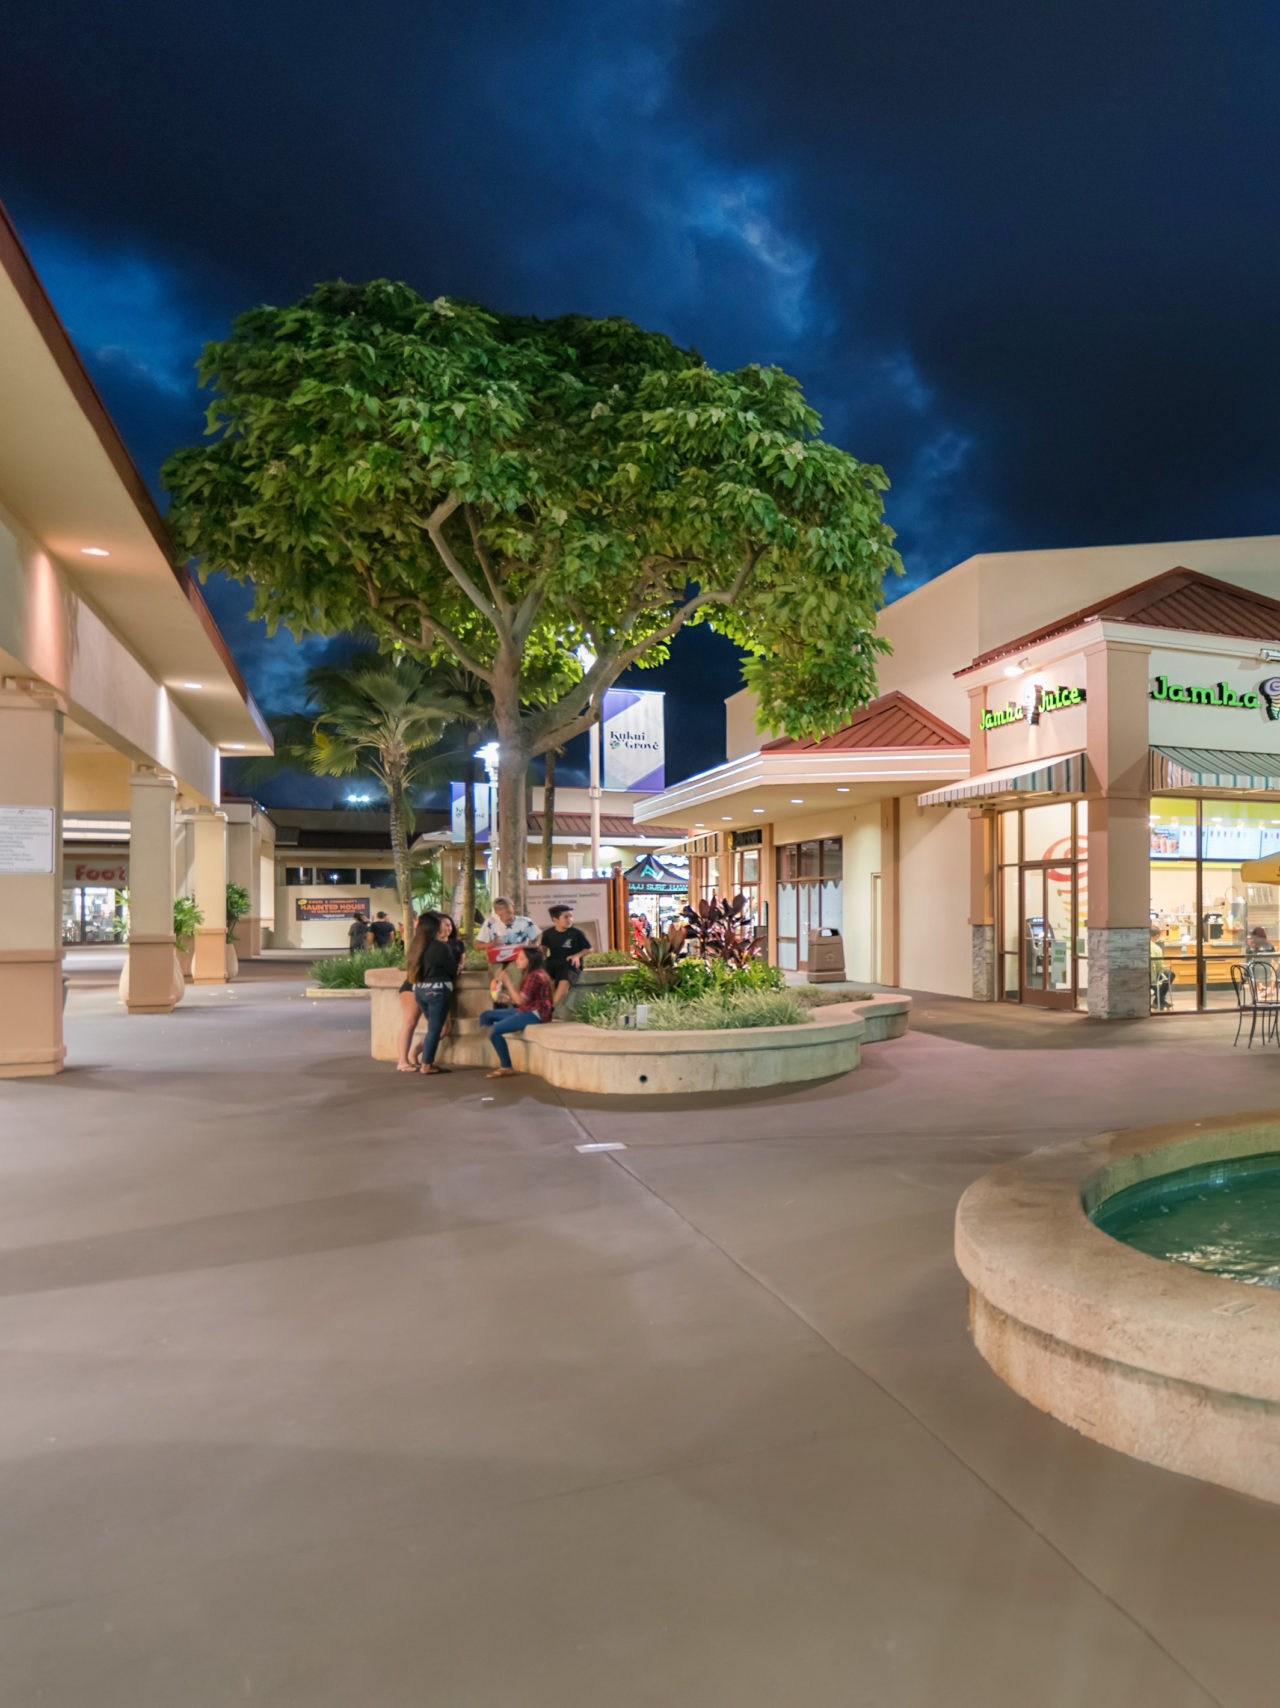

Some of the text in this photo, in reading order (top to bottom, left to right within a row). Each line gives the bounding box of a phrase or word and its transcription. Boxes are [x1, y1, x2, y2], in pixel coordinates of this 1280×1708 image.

[979, 685, 1082, 731] Jamba Juice
[1151, 675, 1262, 709] Jamba
[610, 730, 646, 742] Kukui
